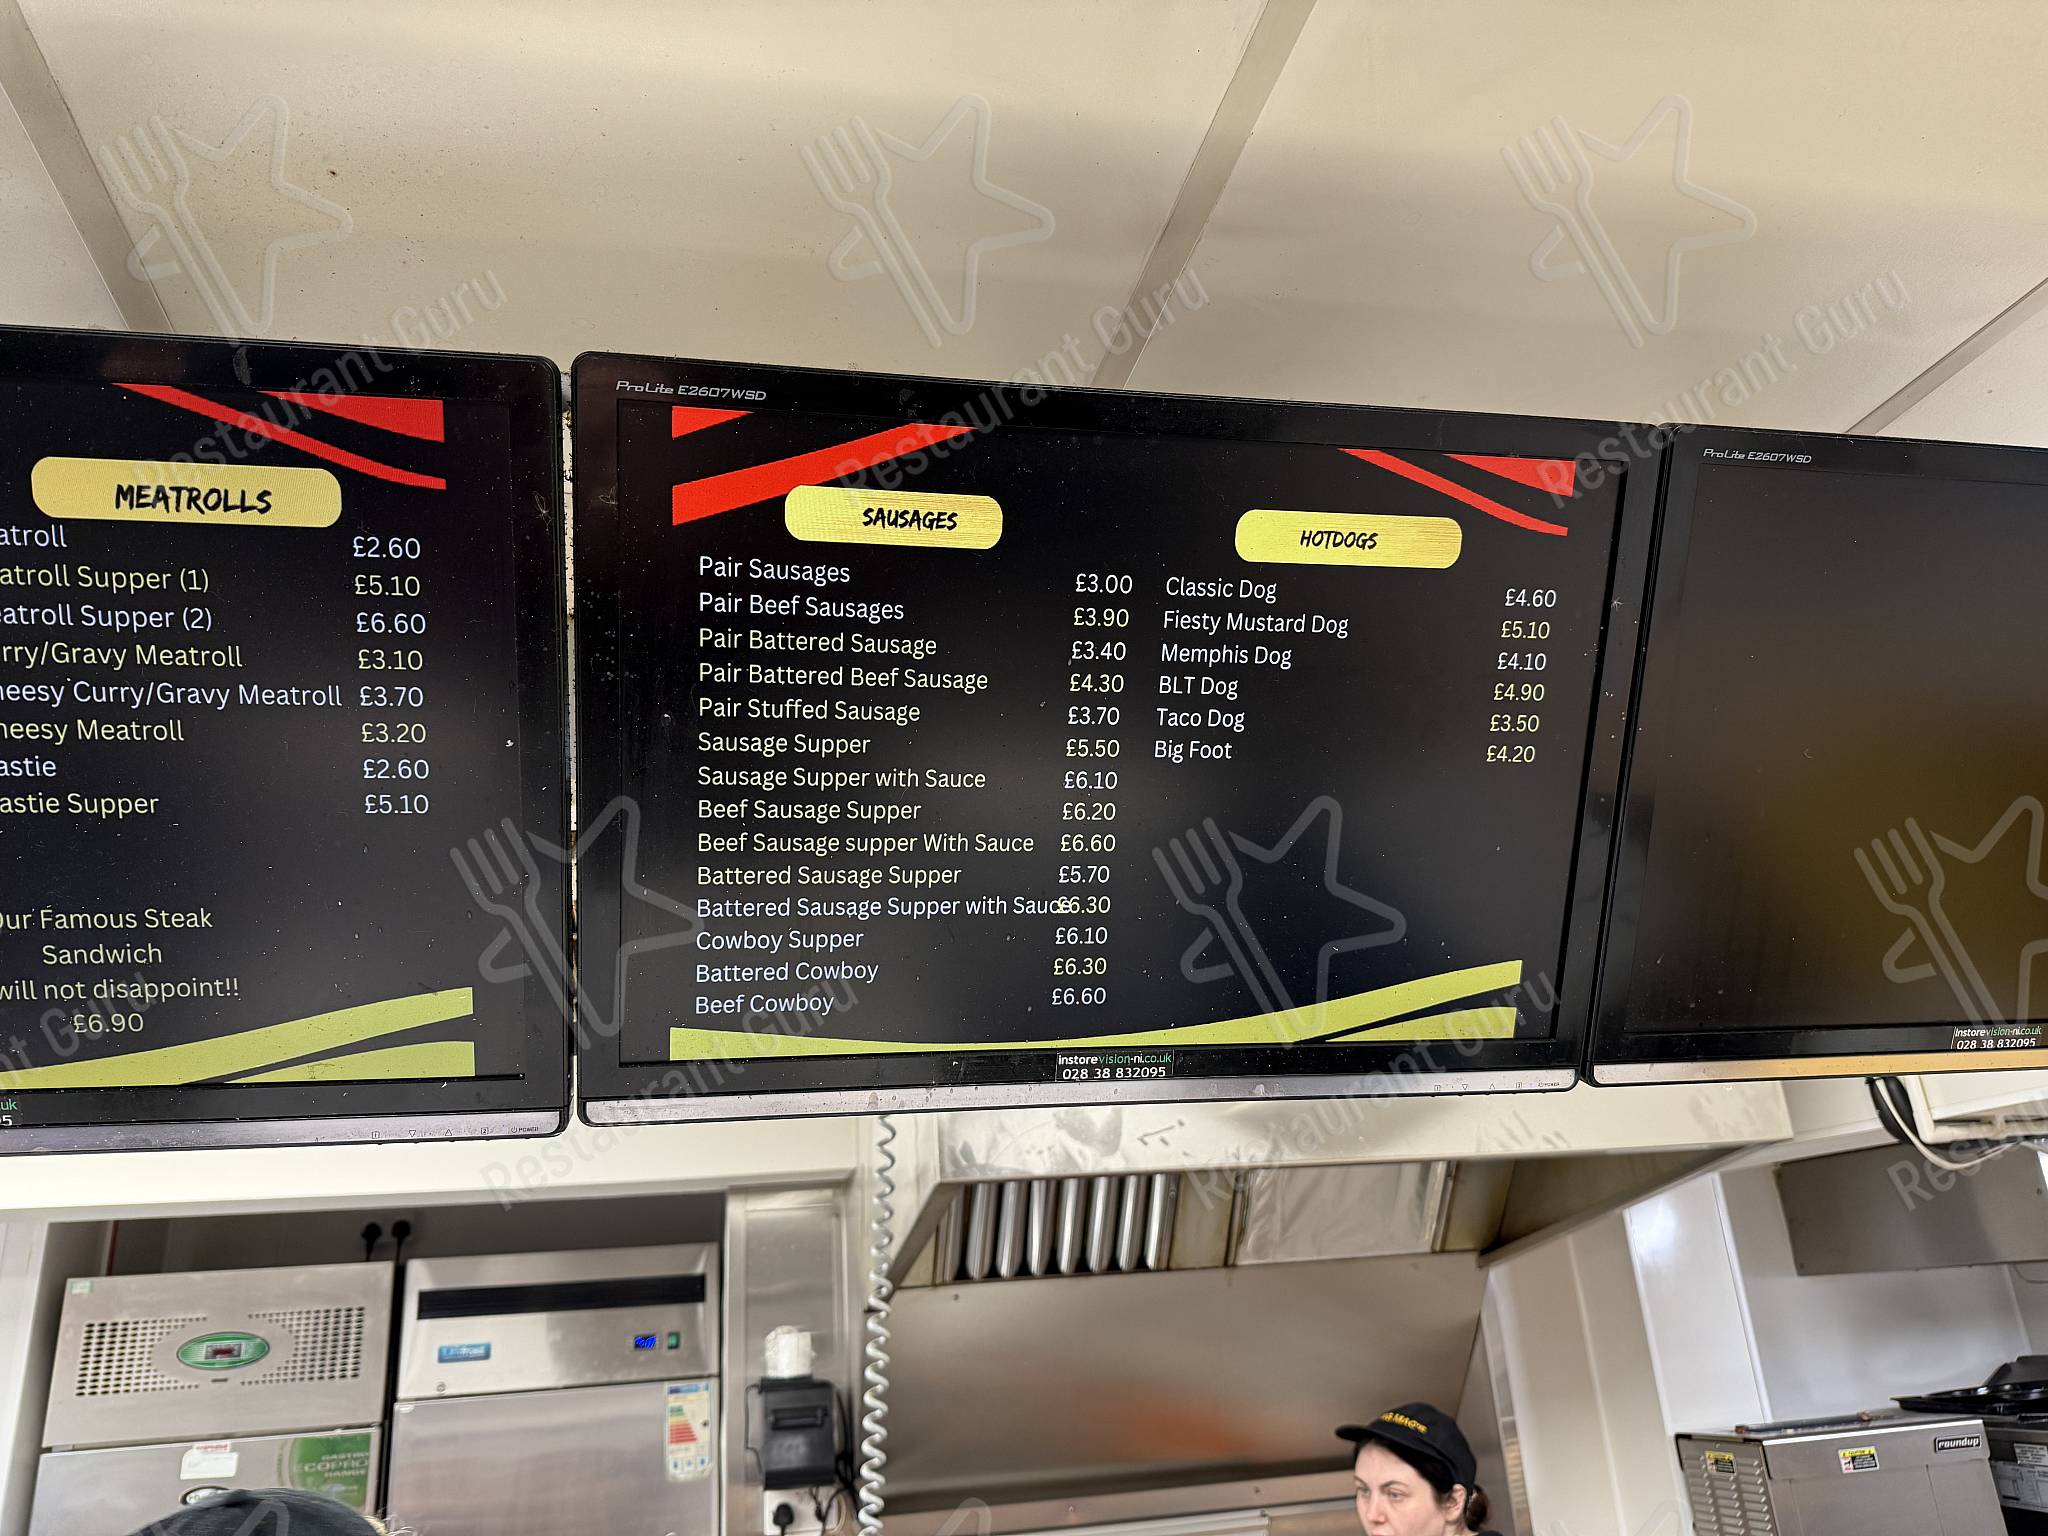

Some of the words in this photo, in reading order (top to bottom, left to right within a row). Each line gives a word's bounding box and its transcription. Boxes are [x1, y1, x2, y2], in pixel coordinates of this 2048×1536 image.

[677, 385, 767, 402] E2607WSD
[1747, 451, 1812, 464] E2607WSD
[115, 484, 272, 514] MEATROLLS
[862, 507, 958, 532] SAUSAGES
[353, 536, 420, 558] £2.60
[1300, 530, 1378, 551] HOTDOGS
[78, 566, 171, 594] Supper
[181, 569, 208, 592] (1)
[355, 575, 420, 596] £5.10
[700, 556, 742, 577] Pair
[750, 559, 850, 586] Sausages
[1076, 573, 1132, 594] £3.00
[1167, 577, 1233, 597] Classic
[1240, 580, 1276, 603] Dog
[1505, 589, 1556, 607] £4.60
[81, 605, 174, 633] Supper
[183, 608, 211, 631] (2)
[357, 612, 425, 634] £6.60
[700, 593, 742, 612] Pair
[750, 595, 800, 615] Beef
[806, 597, 903, 624] Sausages
[1074, 608, 1129, 627] £3.90
[1164, 611, 1221, 635] Fiesty
[1227, 613, 1305, 632] Mustard
[1312, 615, 1348, 638] Dog
[1501, 621, 1550, 639] £5.10
[700, 628, 742, 648] Pair
[750, 630, 843, 651] Battered
[851, 634, 936, 659] Sausage
[1072, 641, 1126, 660] £3.40
[136, 645, 242, 667] Meatroll
[359, 650, 422, 670] £3.10
[1162, 644, 1248, 667] Memphis
[1255, 646, 1291, 669] Dog
[1498, 652, 1546, 670] £4.10
[700, 663, 741, 682] Pair
[750, 665, 842, 685] Battered
[852, 668, 899, 686] Beef
[904, 669, 987, 694] Sausage
[1070, 674, 1124, 692] £4.30
[1160, 676, 1195, 694] BLT
[1201, 677, 1238, 700] Dog
[1494, 683, 1544, 701] £4.90
[74, 681, 229, 710] Curry/Gravy
[239, 685, 342, 706] Meatroll
[360, 686, 423, 707] £3.70
[700, 698, 741, 717] Pair
[748, 699, 827, 719] Stuffed
[835, 701, 920, 726] Sausage
[1068, 706, 1119, 725] £3.70
[1157, 708, 1201, 726] Taco
[1208, 709, 1244, 732] Dog
[1490, 715, 1539, 732] £3.50
[77, 720, 184, 740] Meatroll
[362, 723, 426, 743] £3.20
[699, 732, 787, 757] Sausage
[794, 734, 870, 758] Supper
[1066, 739, 1119, 757] £5.50
[1155, 741, 1183, 763] Big
[1190, 741, 1232, 759] Foot
[1487, 745, 1535, 762] £4.20
[364, 759, 429, 779] £2.60
[698, 766, 787, 791] Sausage
[794, 768, 870, 791] Supper
[876, 768, 918, 787] with
[925, 769, 985, 787] Sauce
[1065, 771, 1117, 789] £6.10
[68, 794, 159, 818] Supper
[365, 794, 428, 813] £5.10
[699, 799, 748, 818] Beef
[754, 800, 840, 824] Sausage
[847, 801, 921, 824] Supper
[1063, 803, 1115, 820] £6.20
[699, 832, 748, 851] Beef
[754, 833, 839, 856] Sausage
[846, 838, 917, 856] supper
[924, 833, 968, 851] With
[975, 834, 1033, 851] Sauce
[1061, 834, 1115, 851] £6.60
[698, 866, 790, 884] Battered
[798, 866, 882, 888] Sausage
[889, 866, 961, 888] Supper
[1059, 866, 1109, 883] £5.70
[41, 910, 137, 928] Famous
[145, 908, 212, 928] Steak
[698, 897, 790, 917] Battered
[797, 898, 881, 920] Sausage
[888, 898, 960, 919] Supper
[966, 896, 1006, 914] with
[697, 931, 783, 953] Cowboy
[789, 931, 864, 952] Supper
[1056, 927, 1107, 944] £6.10
[43, 943, 161, 964] Sandwich
[697, 962, 788, 982] Battered
[796, 961, 878, 983] Cowboy
[1054, 958, 1106, 975] £6.30
[45, 982, 86, 999] not
[94, 978, 239, 1003] disappoint!!
[696, 994, 745, 1014] Beef
[750, 993, 834, 1015] Cowboy
[1052, 988, 1106, 1005] £6.60
[74, 1014, 143, 1032] £6.90
[1956, 1040, 1977, 1050] 028
[1980, 1039, 1994, 1049] 38
[1996, 1038, 2036, 1048] 832095
[1062, 1068, 1089, 1080] 028
[1093, 1068, 1111, 1079] 38
[1115, 1066, 1166, 1078] 832095
[1938, 1437, 1979, 1449] roundup
